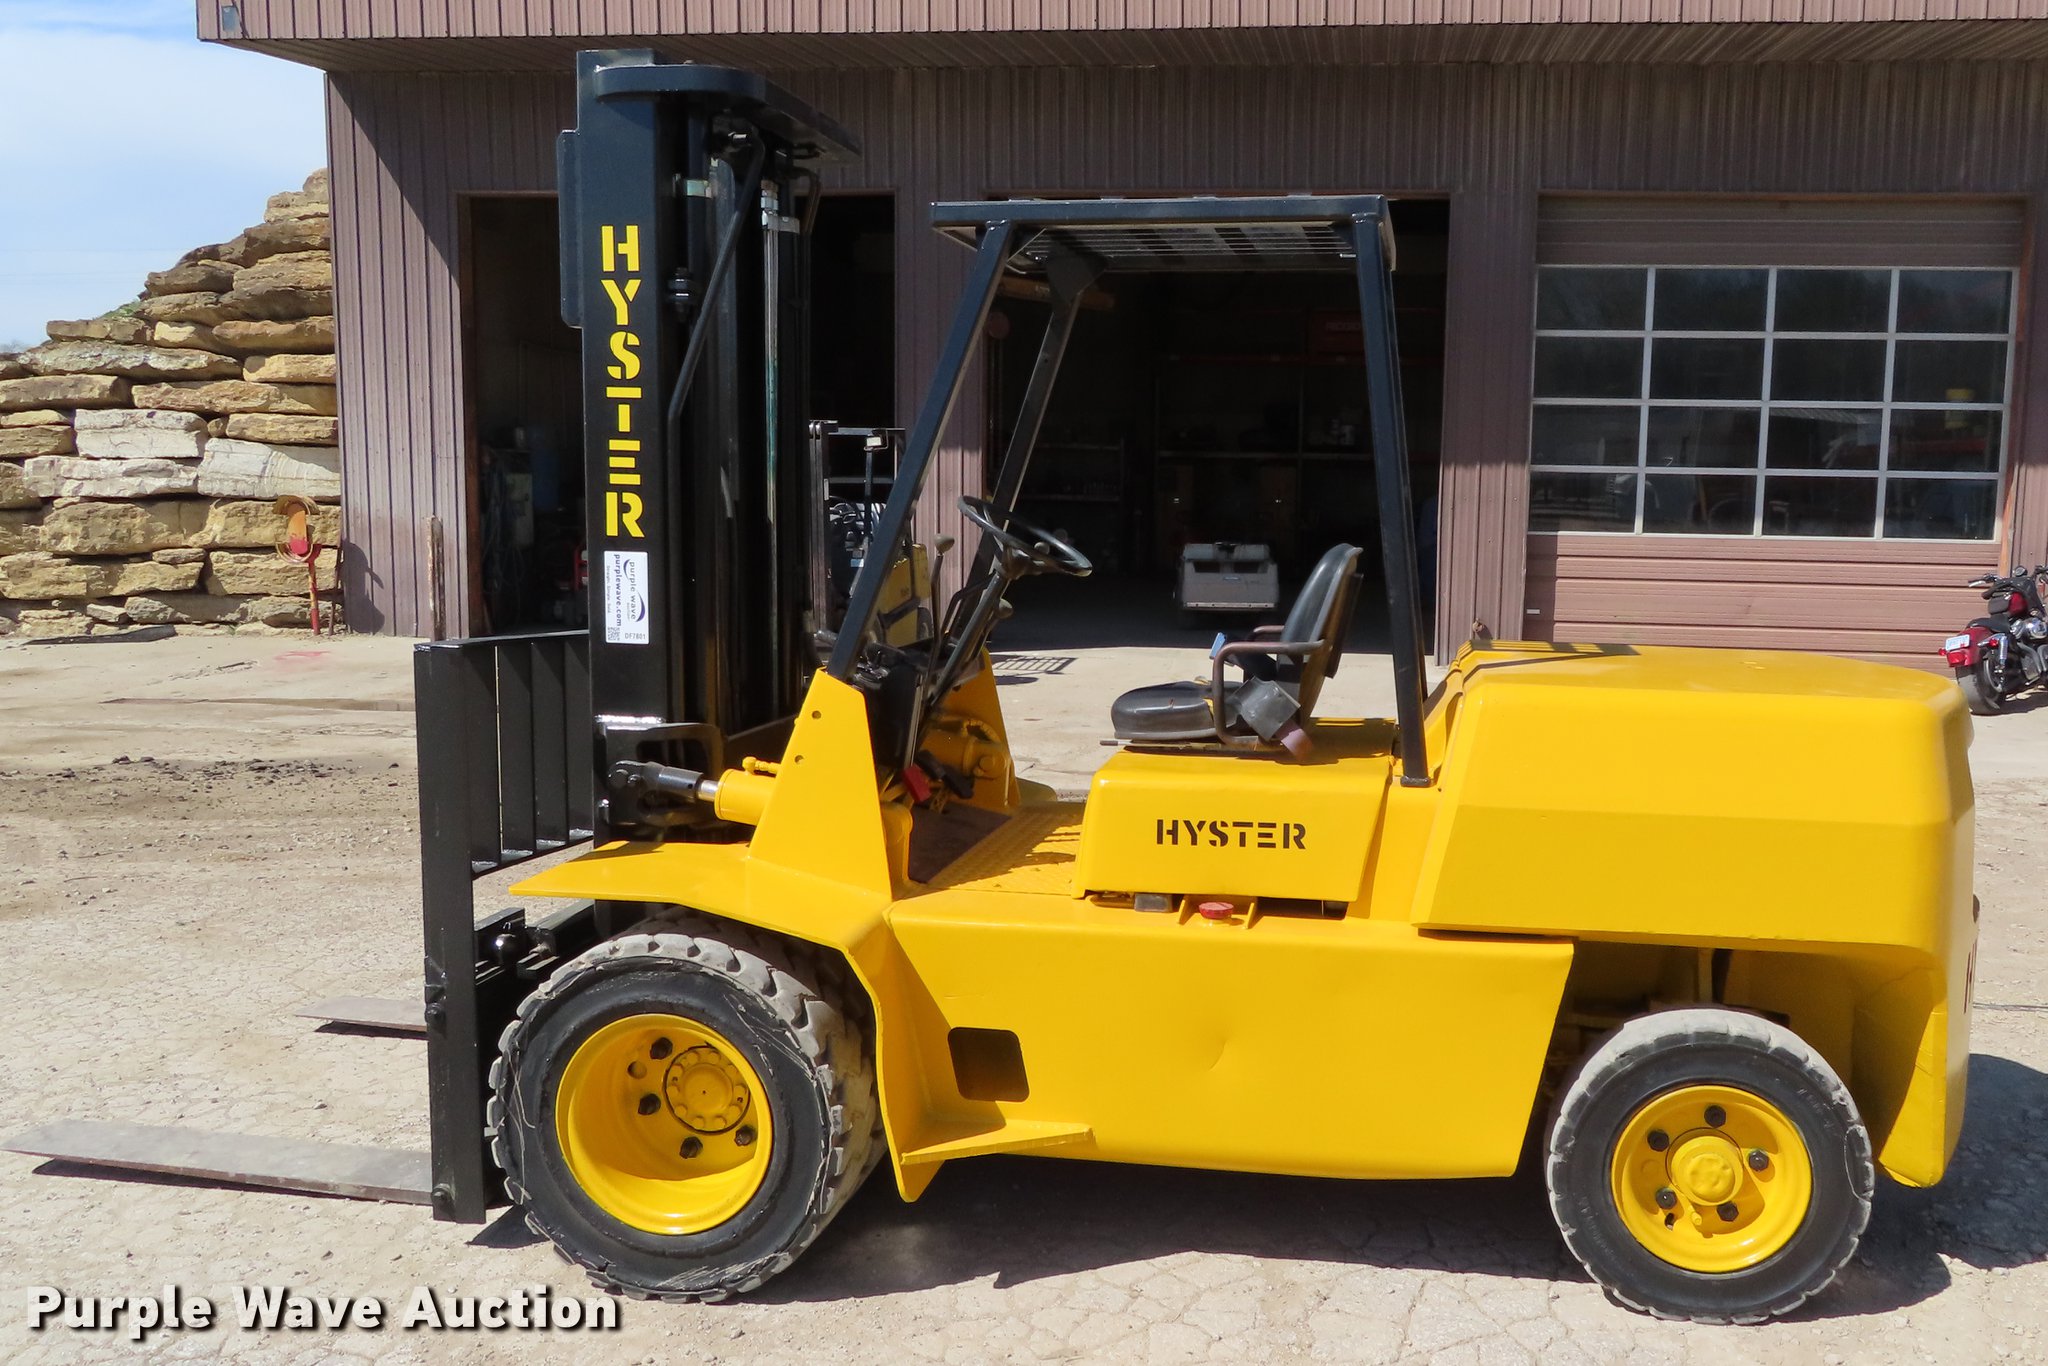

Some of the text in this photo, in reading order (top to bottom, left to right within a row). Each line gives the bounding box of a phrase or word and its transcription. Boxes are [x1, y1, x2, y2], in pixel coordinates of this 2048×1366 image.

[601, 225, 645, 538] HYSTER
[614, 554, 622, 627] purplewave.com
[629, 561, 637, 592] purple
[1156, 819, 1307, 850] HYSTER
